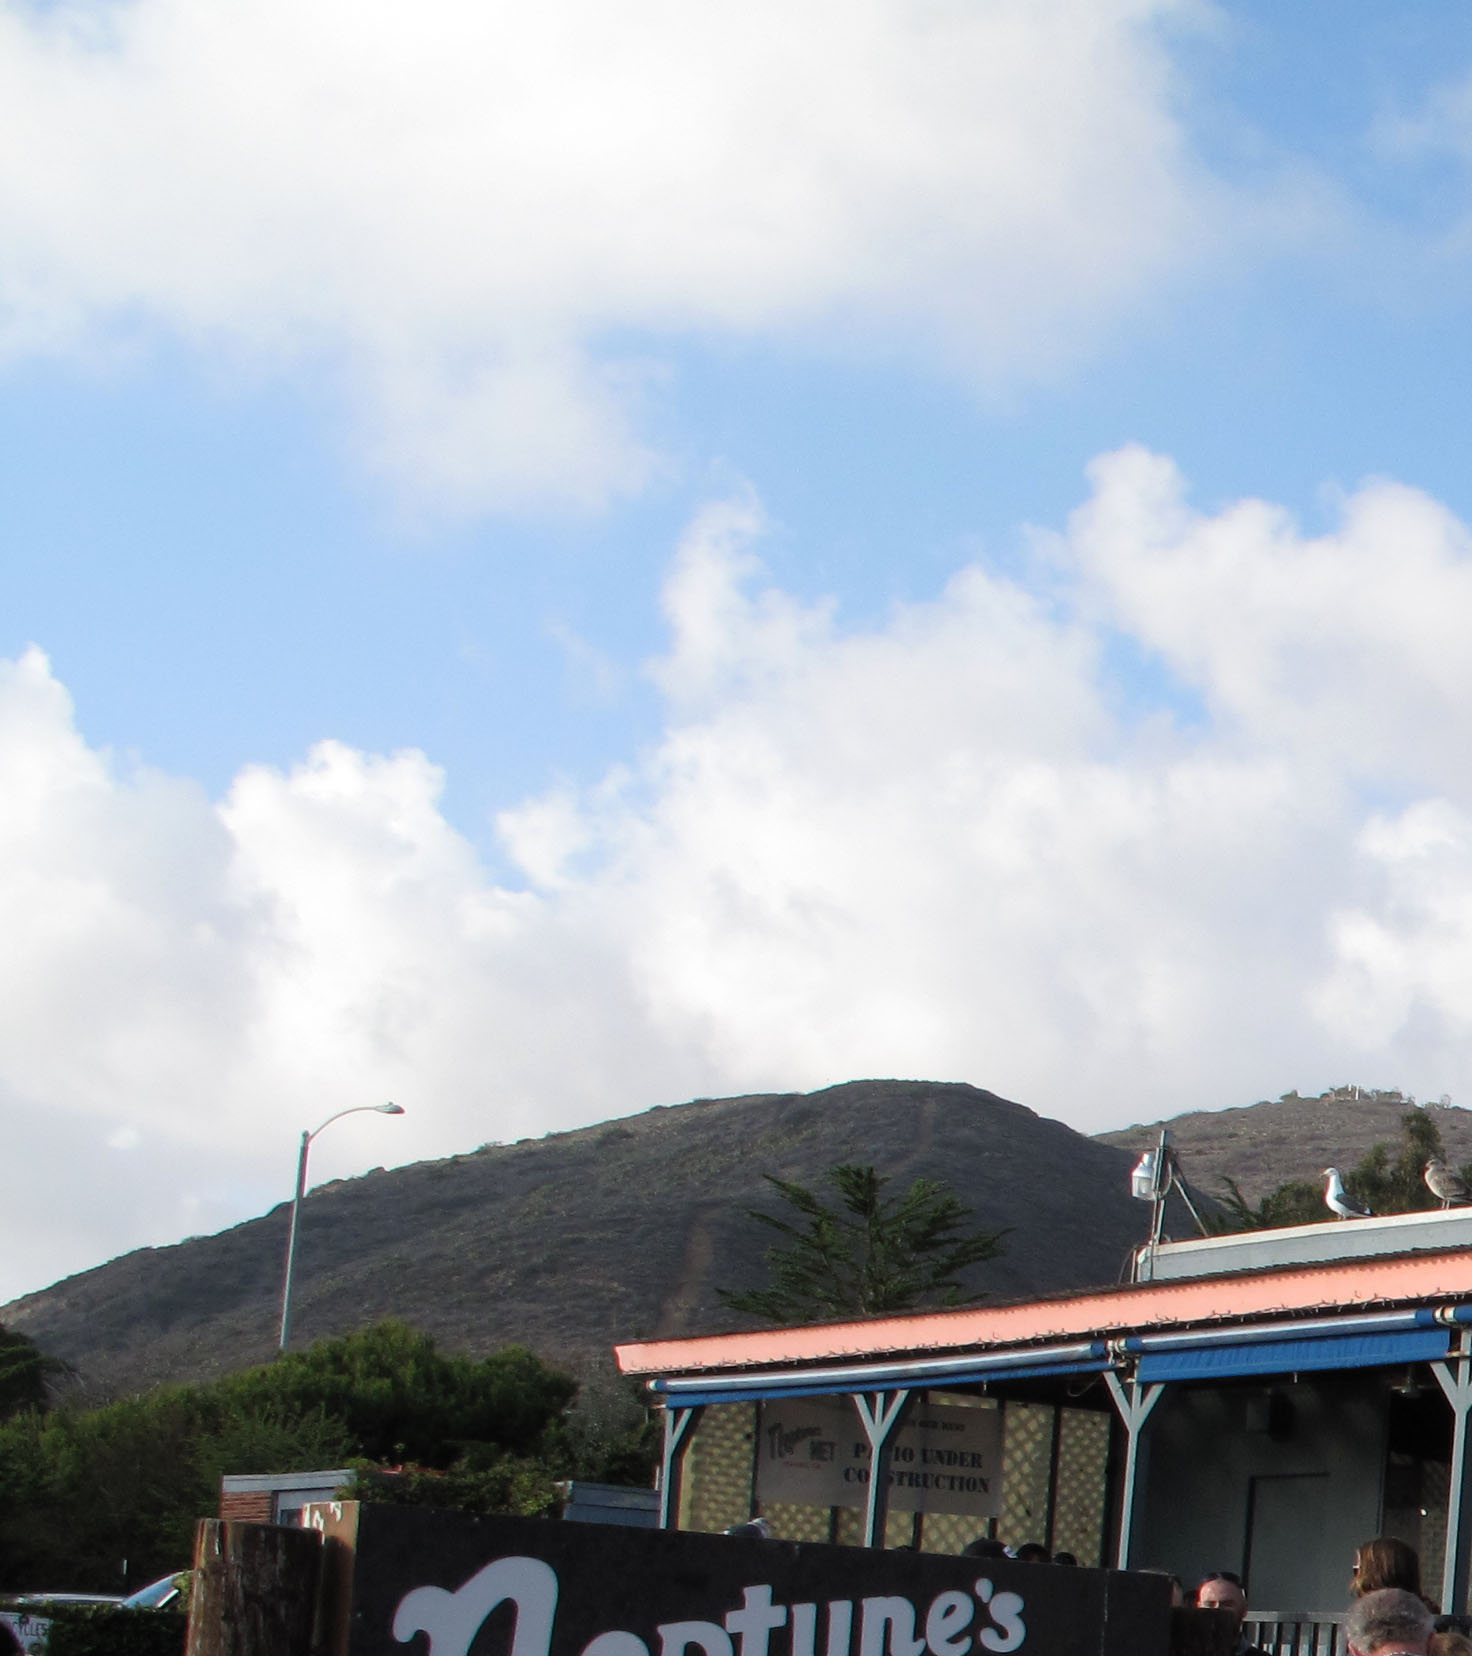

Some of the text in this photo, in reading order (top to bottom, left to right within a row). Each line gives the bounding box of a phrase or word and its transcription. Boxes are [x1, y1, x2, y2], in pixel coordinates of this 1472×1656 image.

[853, 1442, 983, 1469] PIO UNDER
[844, 1467, 990, 1493] COSTRUCTION
